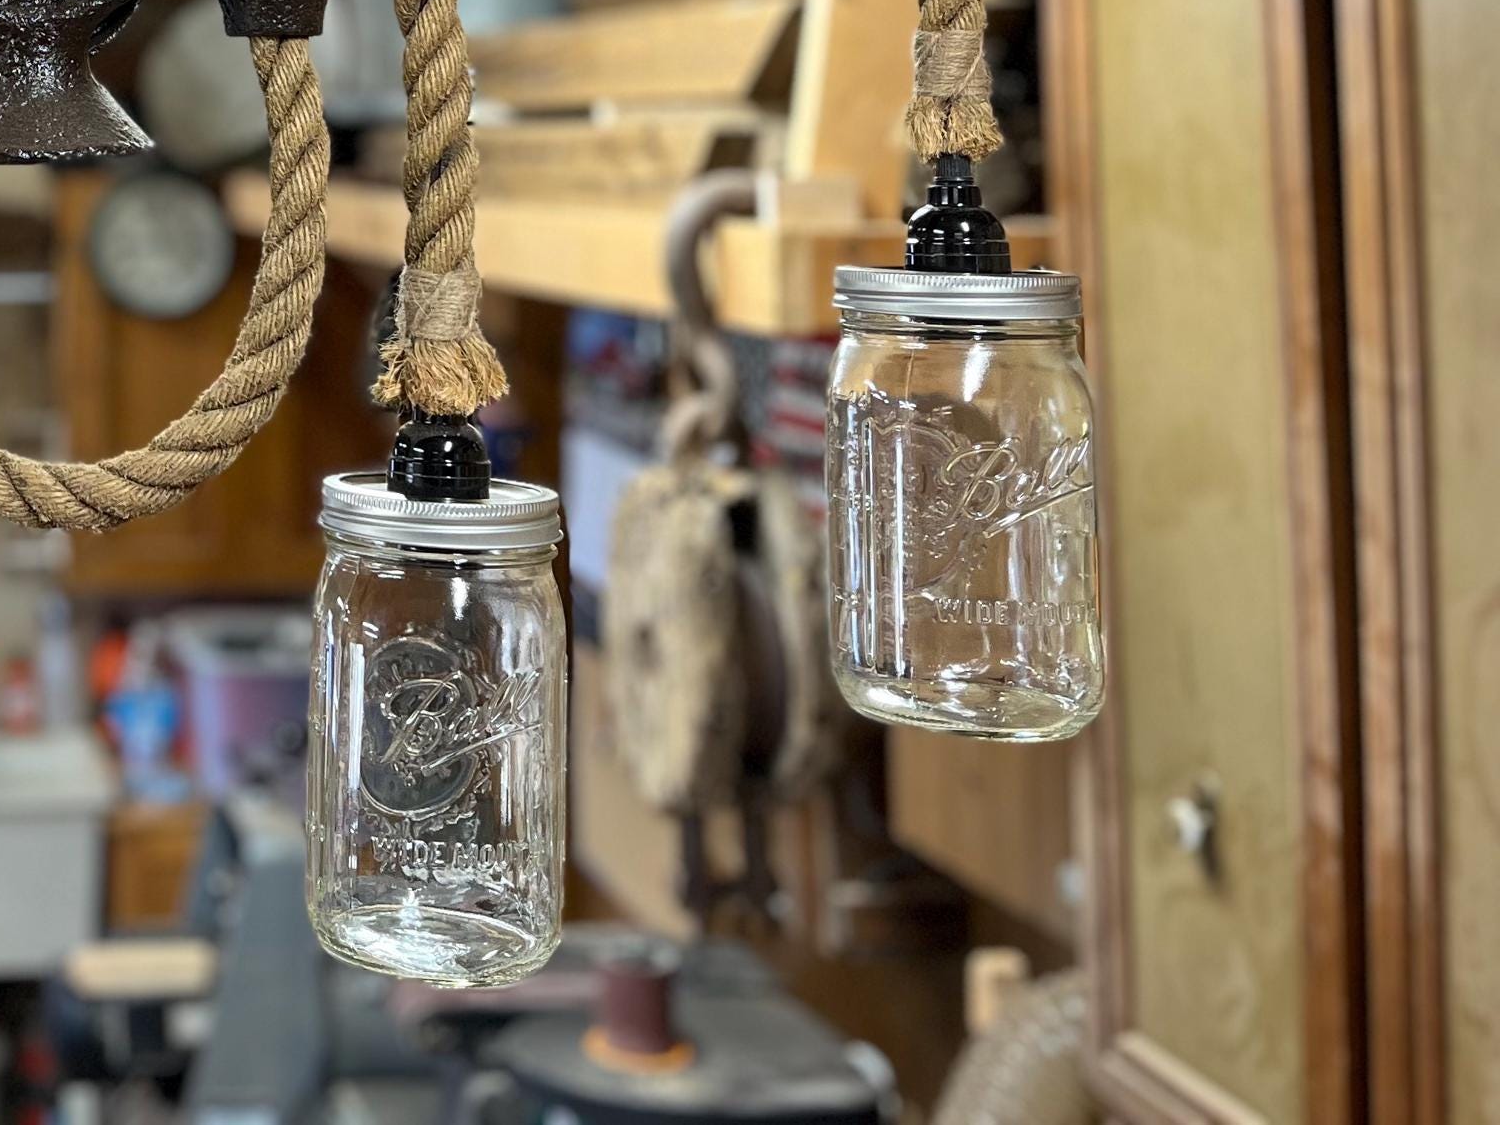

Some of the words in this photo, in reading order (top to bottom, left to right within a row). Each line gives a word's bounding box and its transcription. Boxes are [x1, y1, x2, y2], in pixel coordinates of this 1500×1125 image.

[940, 436, 1093, 538] Ball
[934, 599, 1009, 625] WIDE
[380, 669, 542, 770] Ball
[371, 836, 447, 868] WIDE
[452, 841, 540, 871] MOUT
